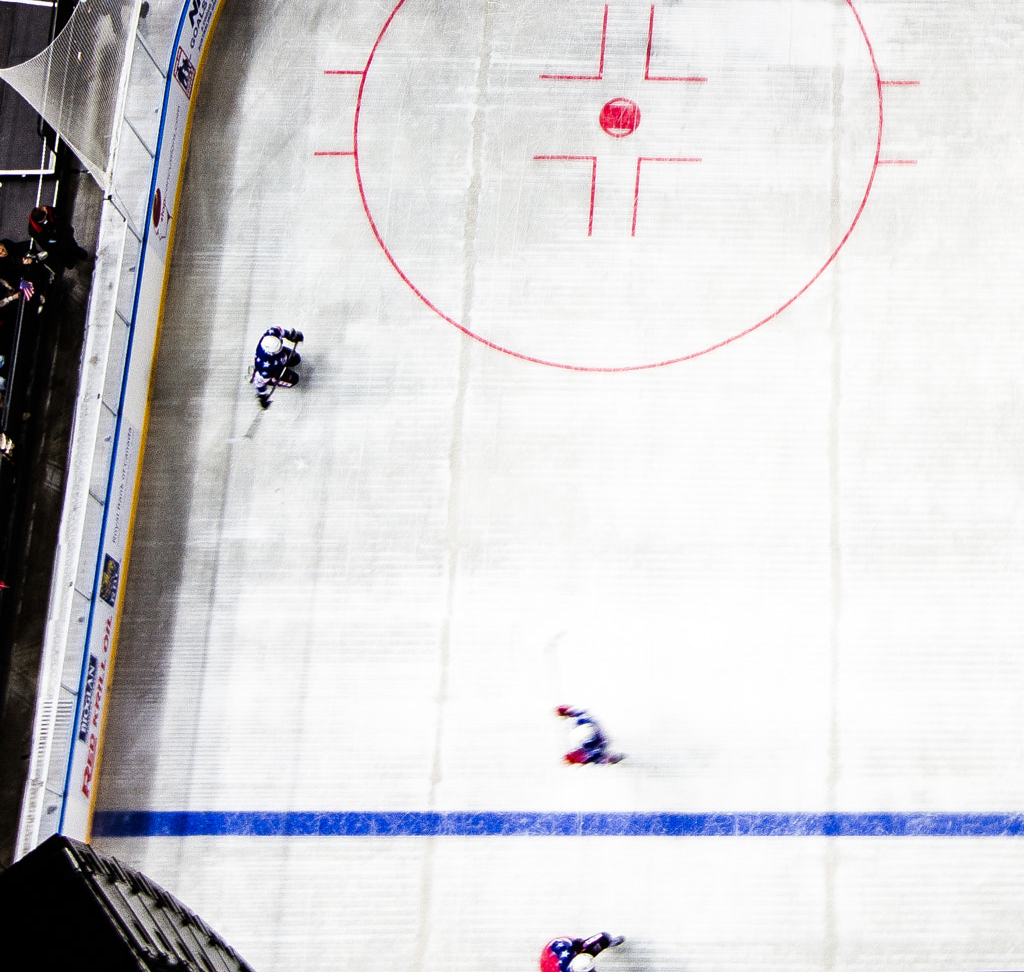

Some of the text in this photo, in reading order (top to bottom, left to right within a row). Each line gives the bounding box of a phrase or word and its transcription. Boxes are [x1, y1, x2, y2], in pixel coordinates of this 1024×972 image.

[190, 0, 207, 48] GOALS
[80, 667, 96, 732] BIOGLAN
[80, 616, 112, 798] RED KRILL OIL
